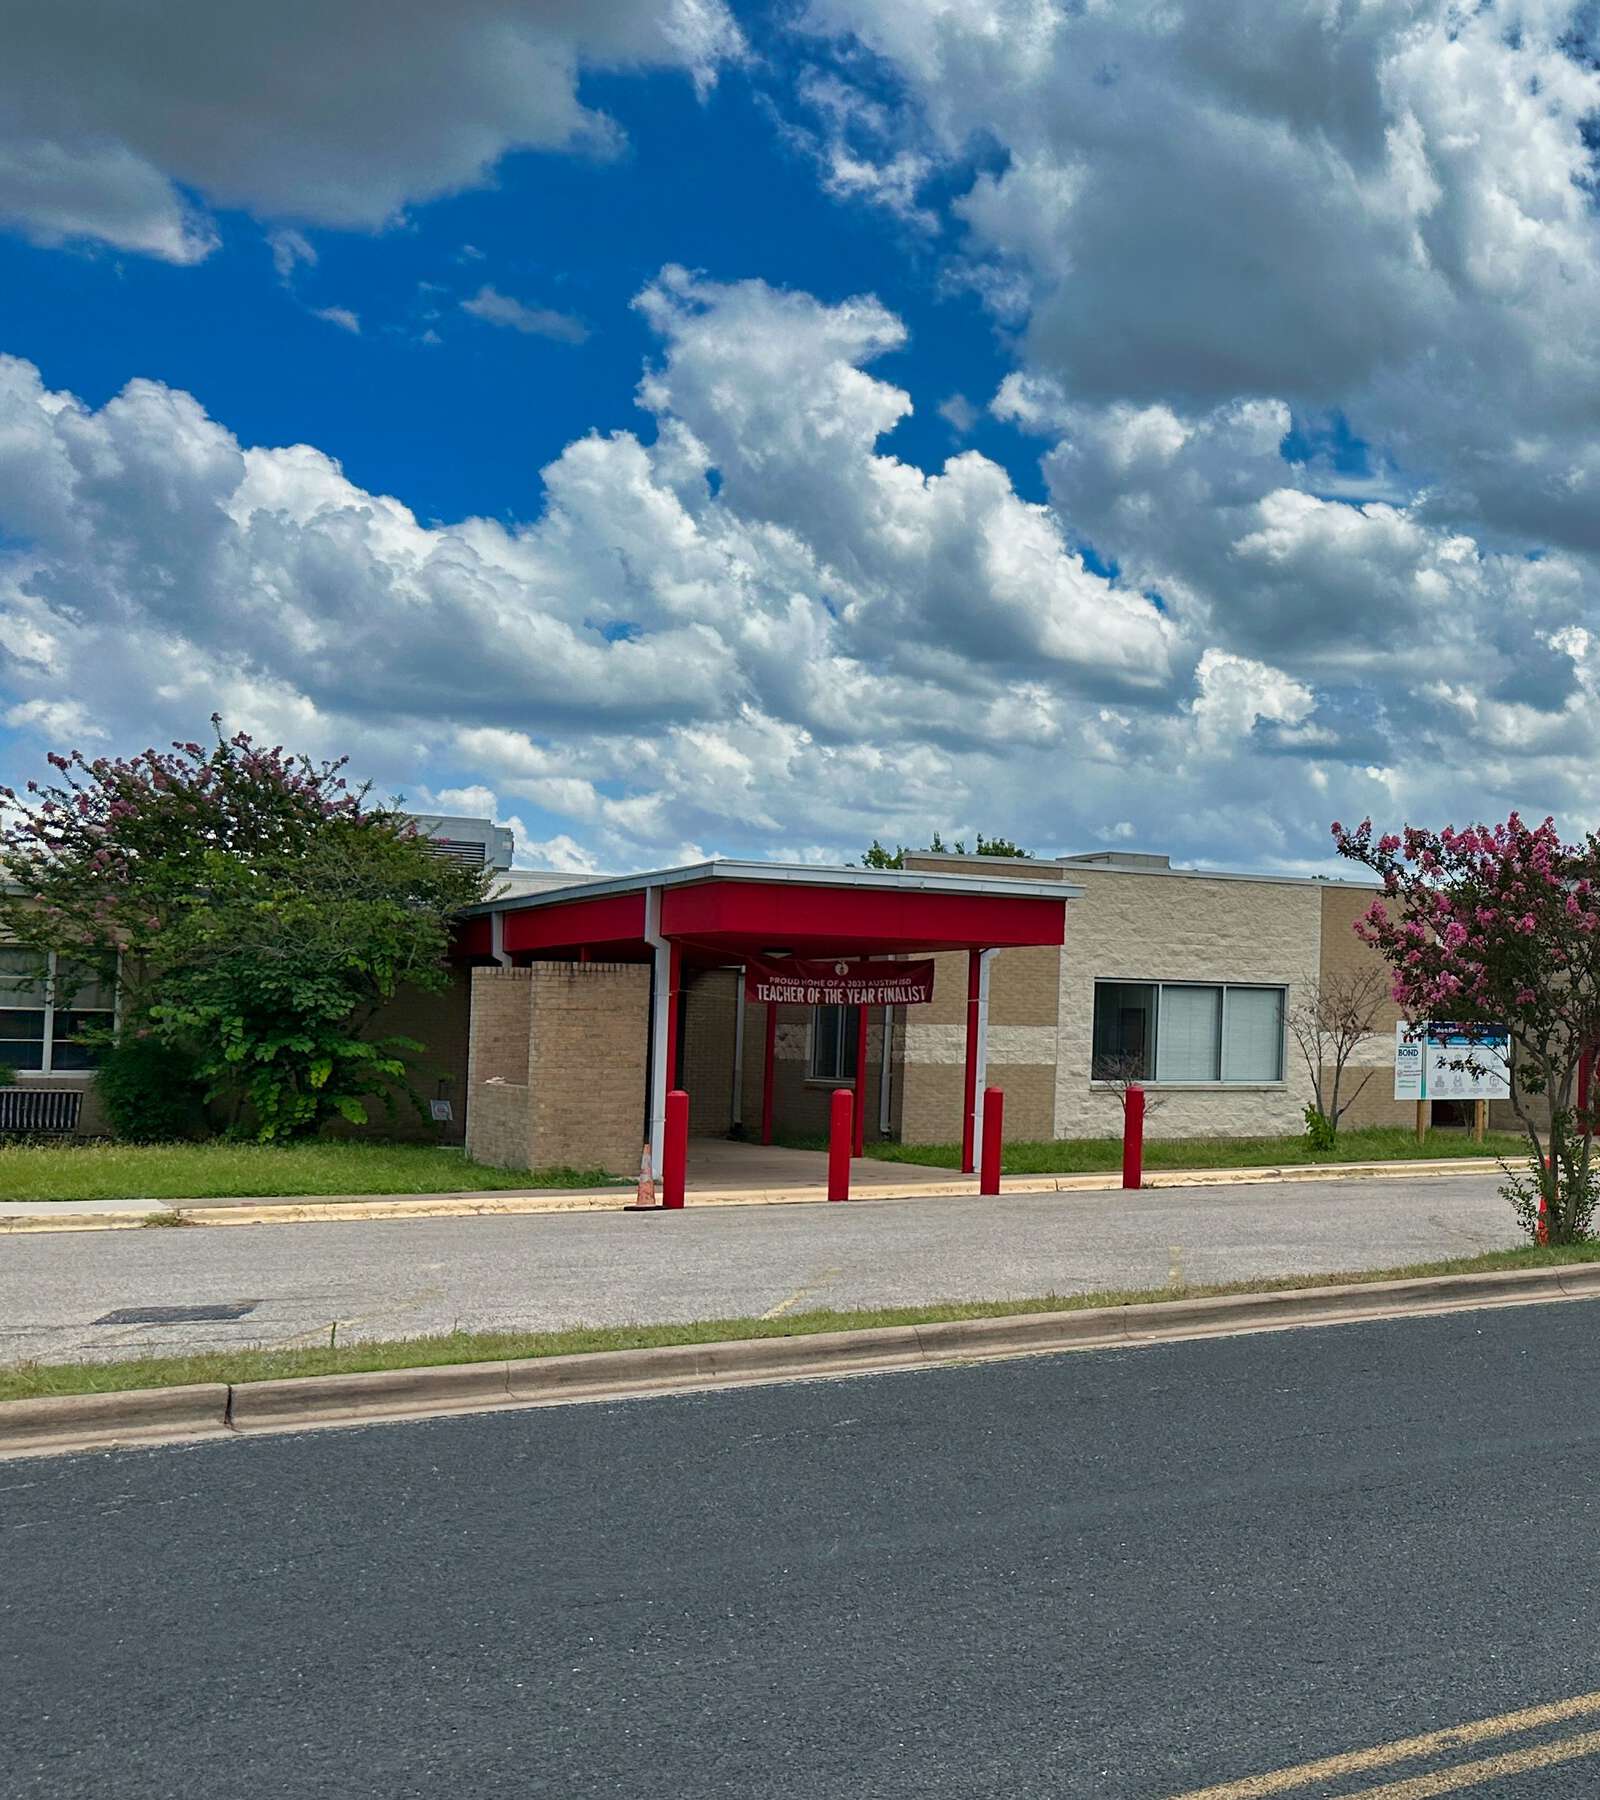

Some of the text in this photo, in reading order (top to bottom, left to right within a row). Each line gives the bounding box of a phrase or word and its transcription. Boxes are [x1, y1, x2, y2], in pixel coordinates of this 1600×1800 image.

[769, 976, 800, 985] PROUD
[801, 979, 825, 987] HOME
[826, 979, 838, 987] OF
[757, 984, 926, 1004] TEACHER OF THE YEAR FINALIST
[1398, 1049, 1419, 1057] BOND
